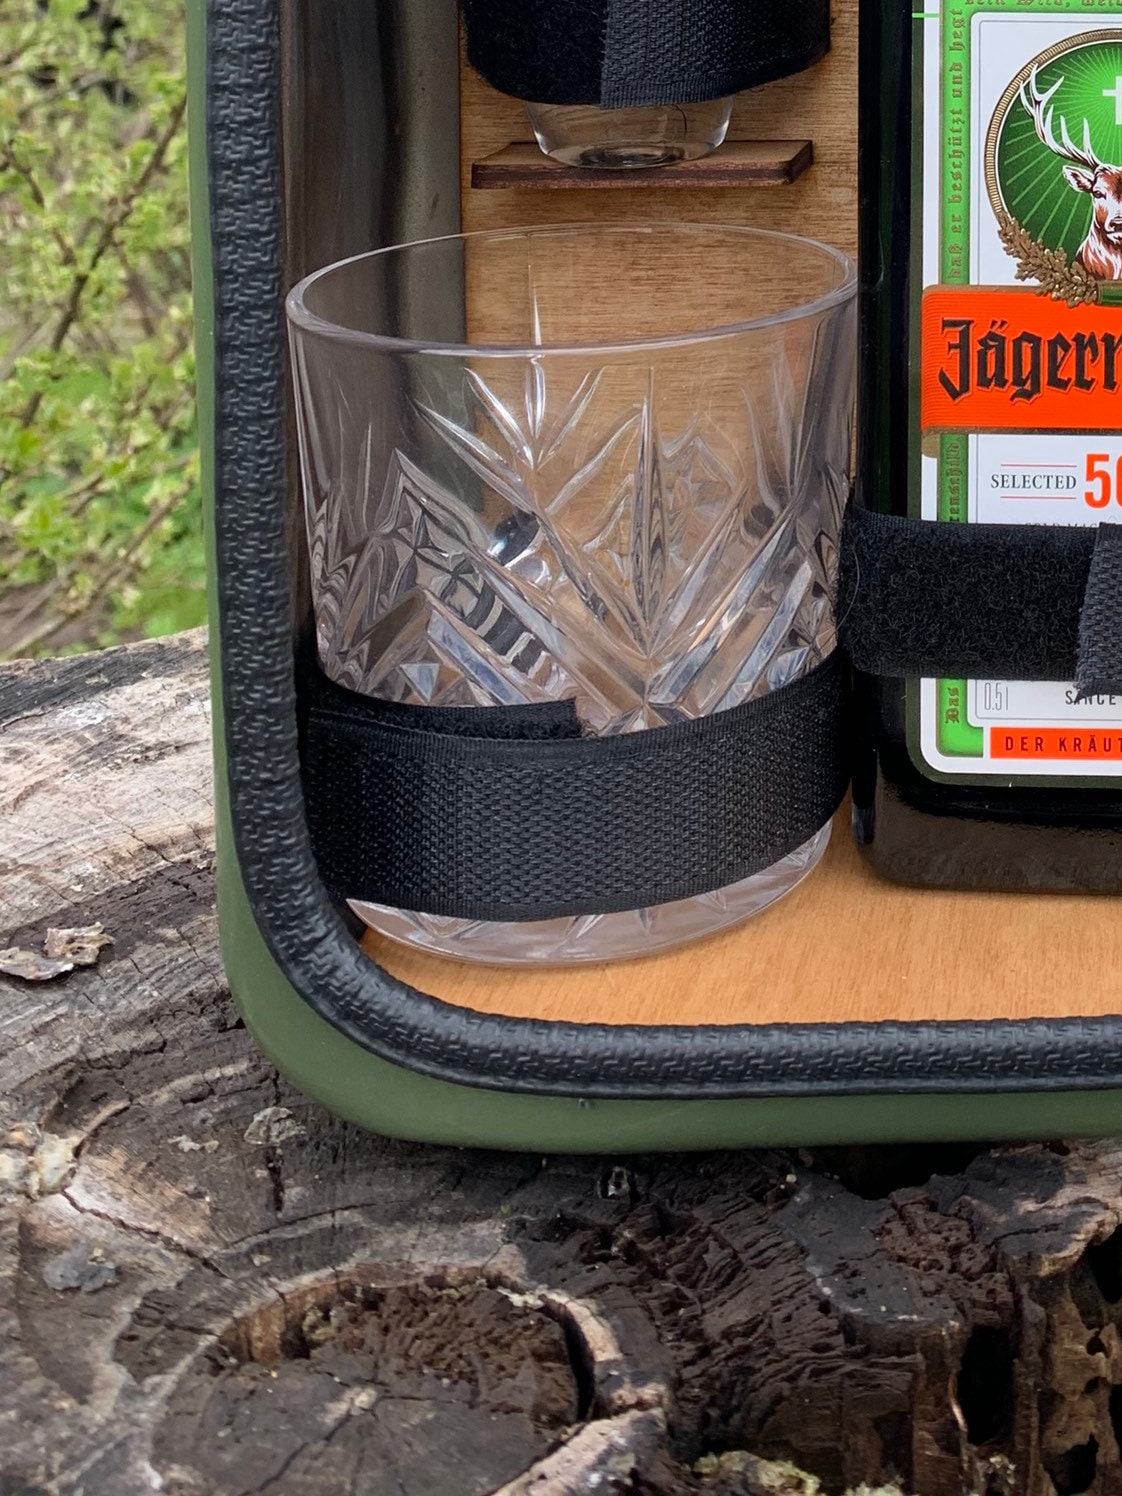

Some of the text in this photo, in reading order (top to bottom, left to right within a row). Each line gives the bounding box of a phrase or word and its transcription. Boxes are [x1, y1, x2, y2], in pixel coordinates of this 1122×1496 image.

[949, 8, 966, 51] hegt
[949, 61, 963, 98] und
[949, 213, 962, 234] er
[991, 474, 1077, 490] SELECTED
[1065, 690, 1116, 706] SNCE
[1005, 736, 1044, 751] DER
